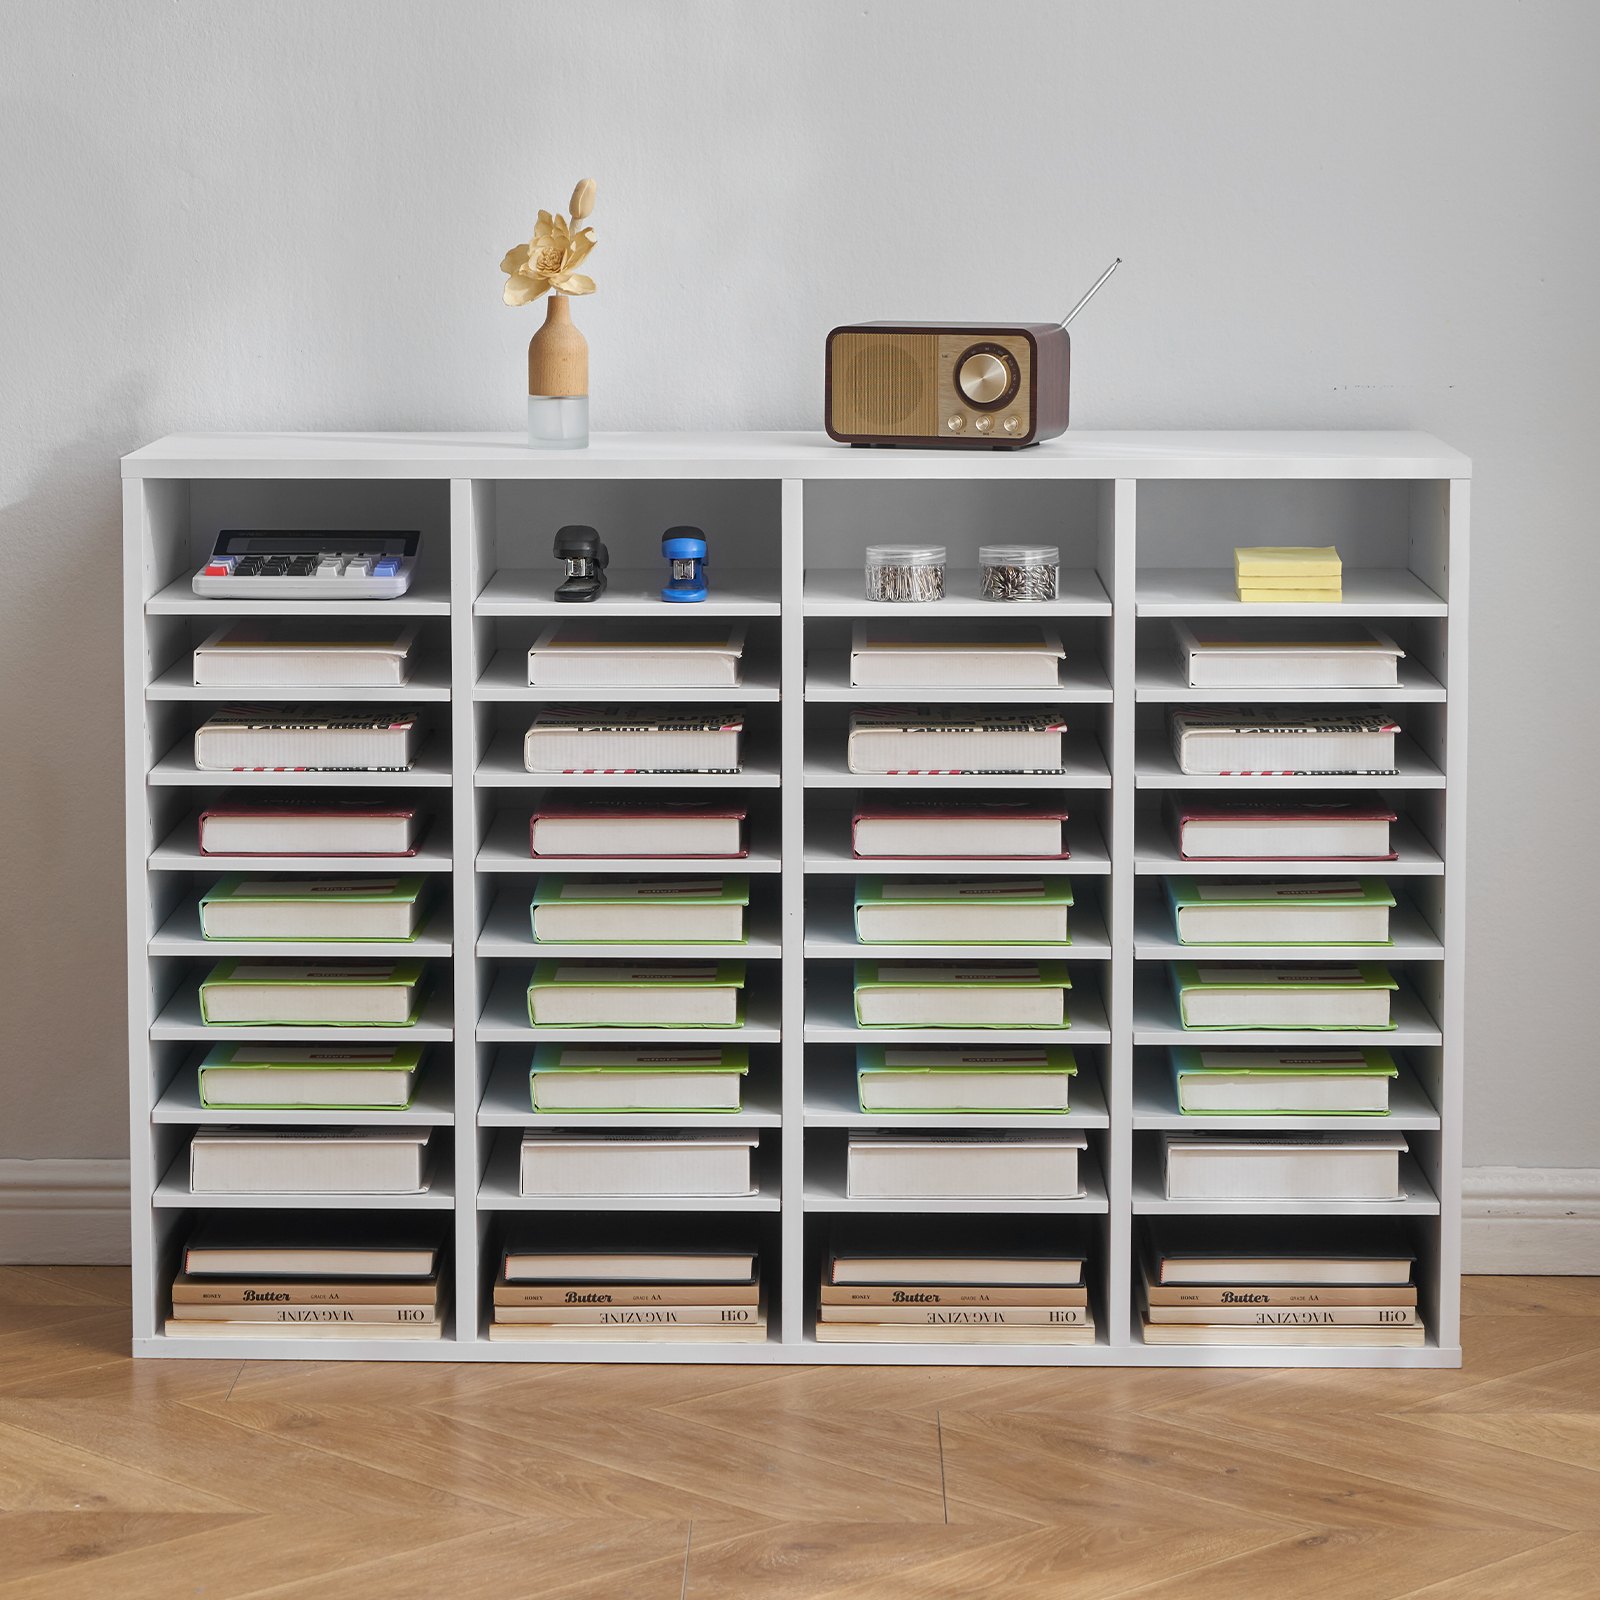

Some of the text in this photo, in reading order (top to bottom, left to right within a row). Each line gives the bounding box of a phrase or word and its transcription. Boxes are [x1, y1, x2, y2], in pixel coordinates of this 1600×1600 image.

[242, 1289, 291, 1303] Butter
[564, 1291, 614, 1304] Butter
[891, 1290, 941, 1304] Butter
[1220, 1290, 1271, 1304] Butter
[277, 1310, 354, 1322] MAGAZINE
[599, 1312, 677, 1324] MAGAZINE
[927, 1312, 1006, 1324] MAGAZINE
[1256, 1311, 1335, 1324] MAGAZINE
